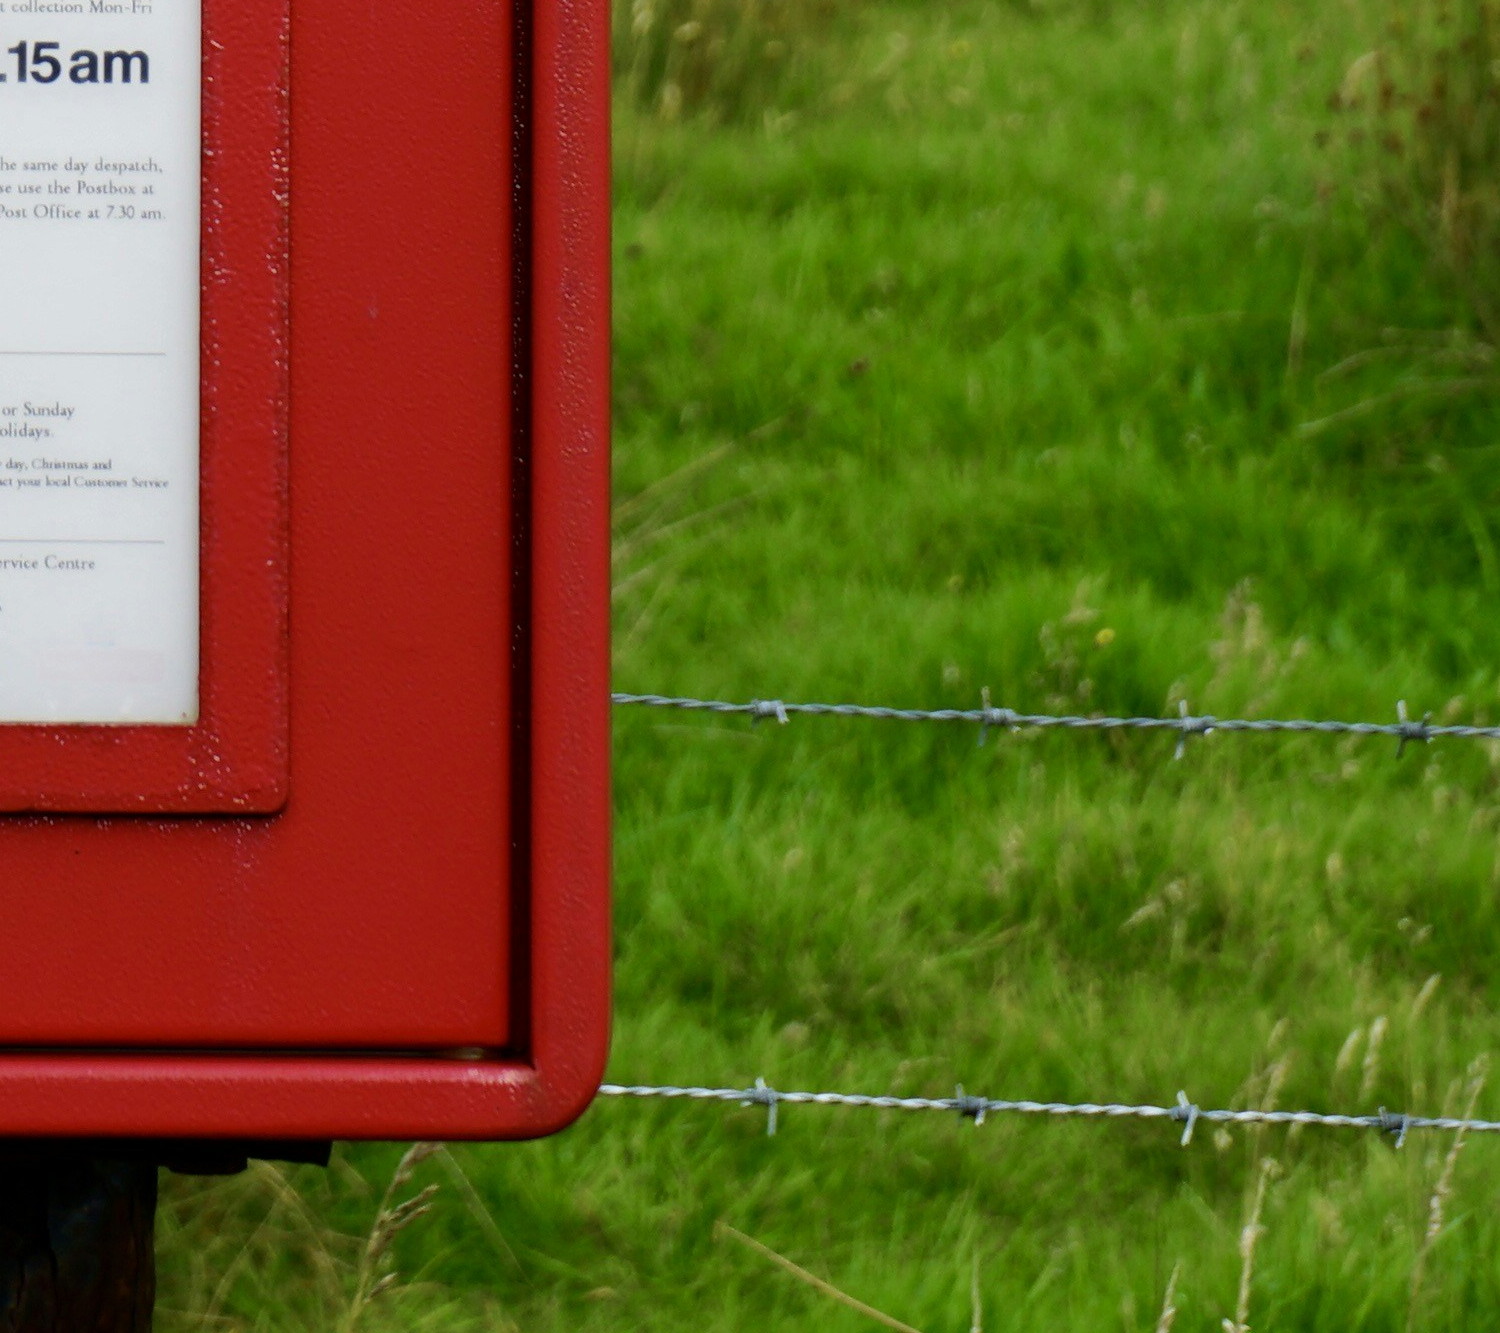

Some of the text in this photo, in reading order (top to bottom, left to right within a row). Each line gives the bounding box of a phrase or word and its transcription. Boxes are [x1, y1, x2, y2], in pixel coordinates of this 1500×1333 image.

[23, 162, 58, 172] same
[64, 157, 89, 176] day
[95, 156, 163, 176] despatch,
[18, 185, 42, 194] use
[48, 179, 71, 194] the
[77, 179, 136, 196] Postbox
[142, 185, 154, 195] at
[33, 204, 83, 221] Office
[87, 209, 101, 220] at
[106, 204, 135, 220] 7.30
[140, 206, 167, 221] am.
[2, 407, 18, 416] or
[23, 401, 75, 420] Sunday
[44, 554, 95, 571] Centre
